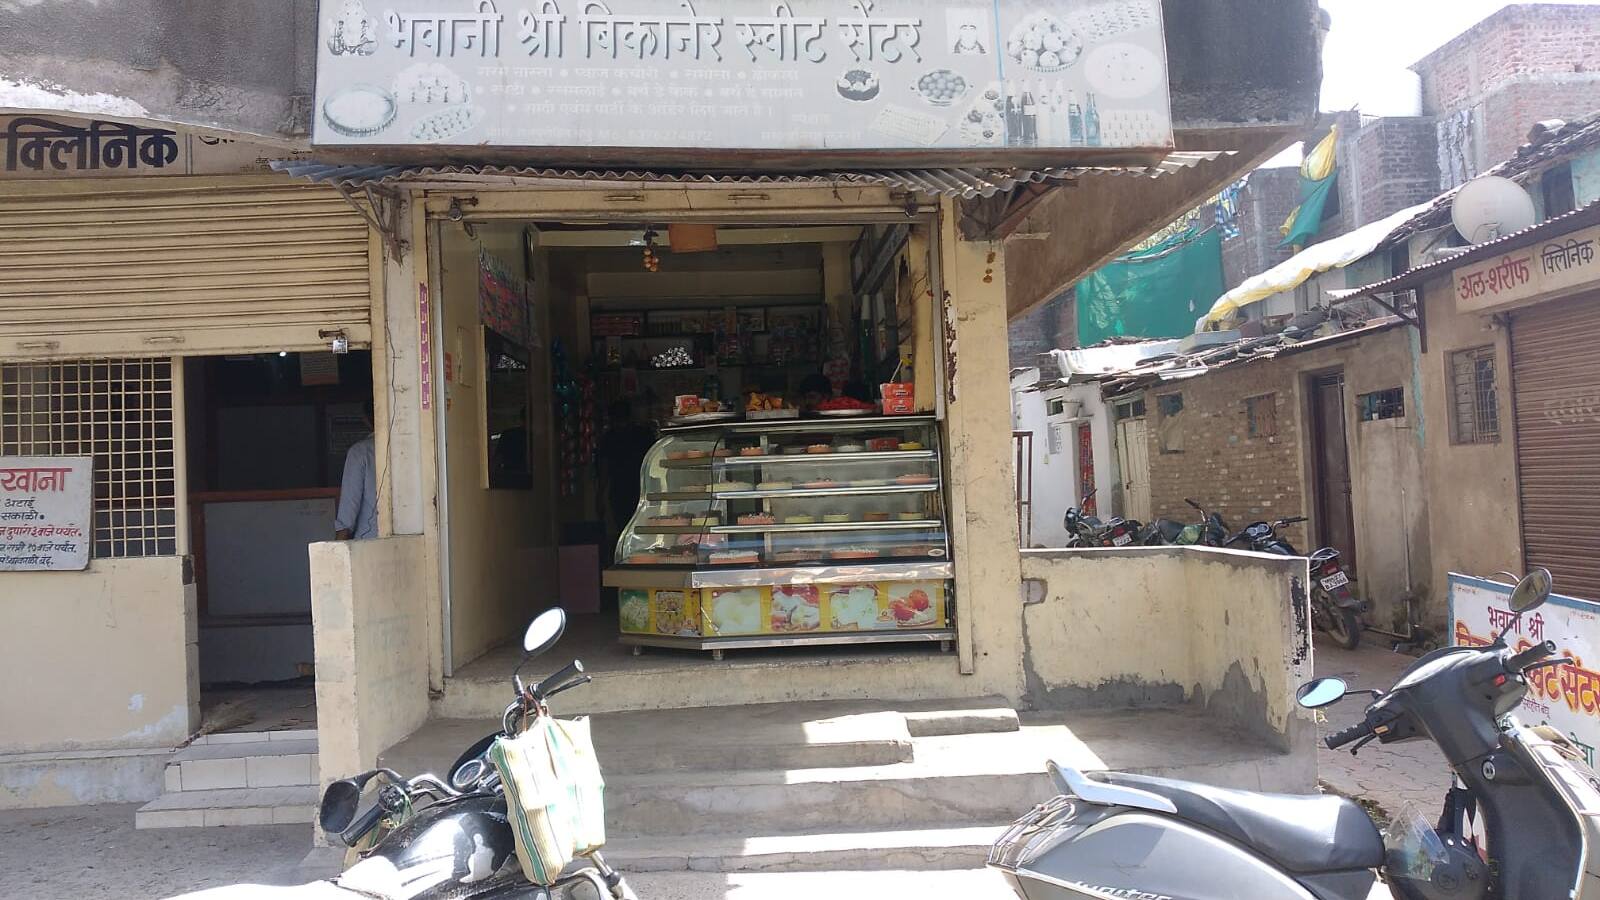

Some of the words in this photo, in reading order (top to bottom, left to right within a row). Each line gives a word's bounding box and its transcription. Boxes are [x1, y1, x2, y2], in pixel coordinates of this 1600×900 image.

[386, 0, 504, 58] भवानी
[519, 0, 567, 58] श्री
[578, 1, 723, 63] बिकानेर
[735, 0, 827, 64] स्वीट
[5, 116, 178, 171] क्लिनिक
[1541, 238, 1594, 276] क्लिनिक
[1528, 612, 1545, 641] श्री
